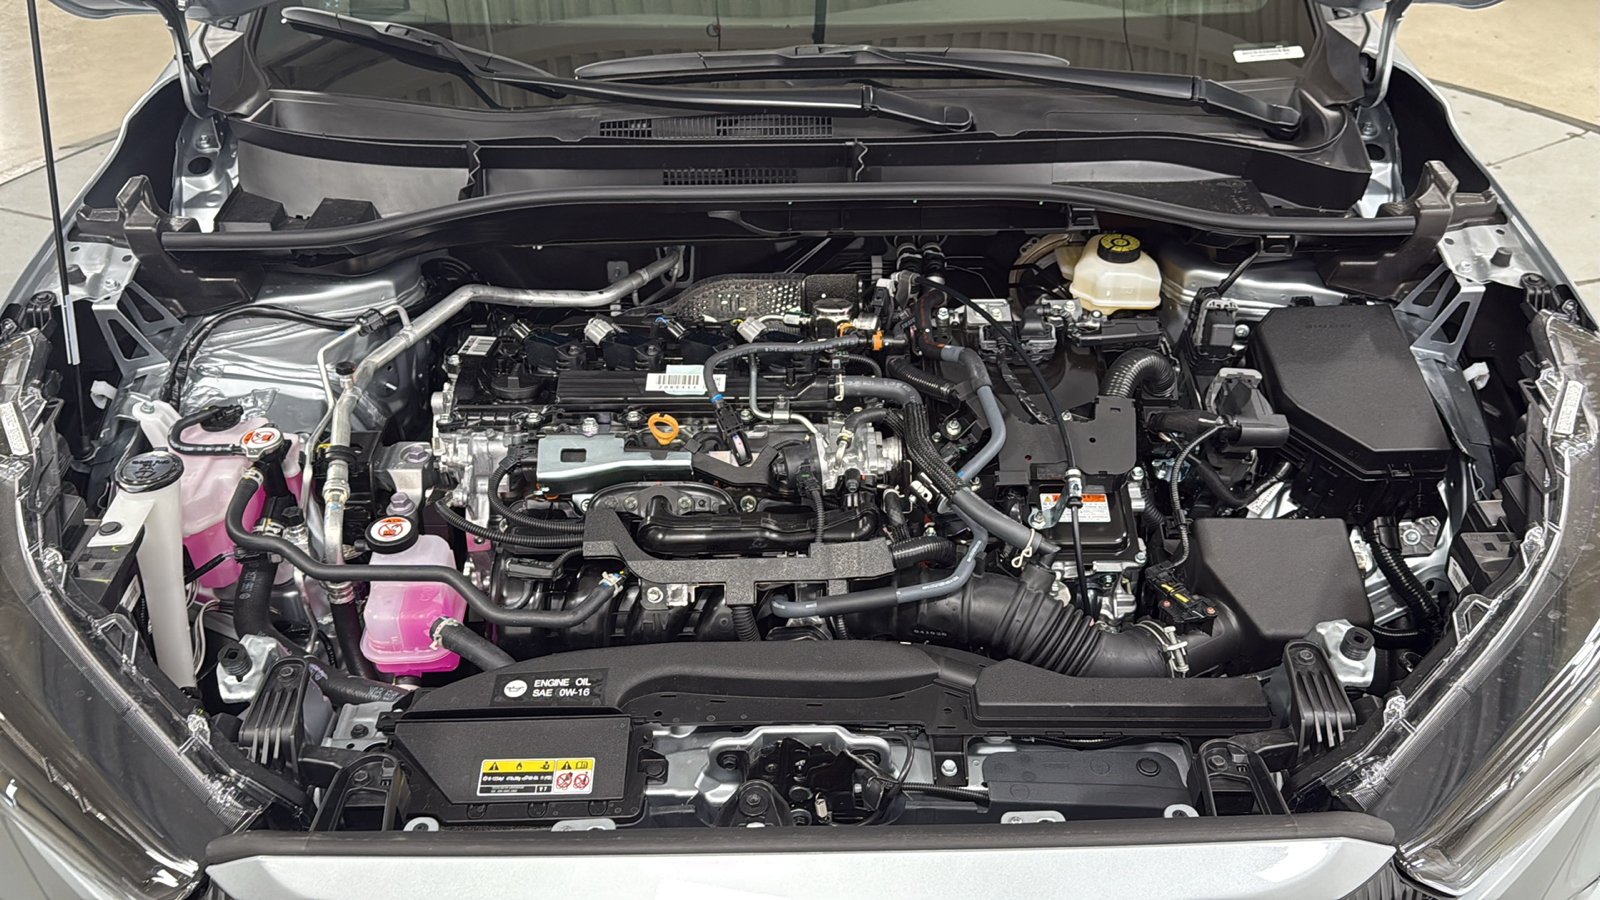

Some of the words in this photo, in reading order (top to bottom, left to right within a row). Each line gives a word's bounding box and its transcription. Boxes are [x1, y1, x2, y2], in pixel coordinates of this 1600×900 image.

[534, 678, 570, 687] ENGINE
[575, 677, 592, 686] OIL
[532, 688, 553, 697] SAE
[558, 688, 590, 697] 0W-16
